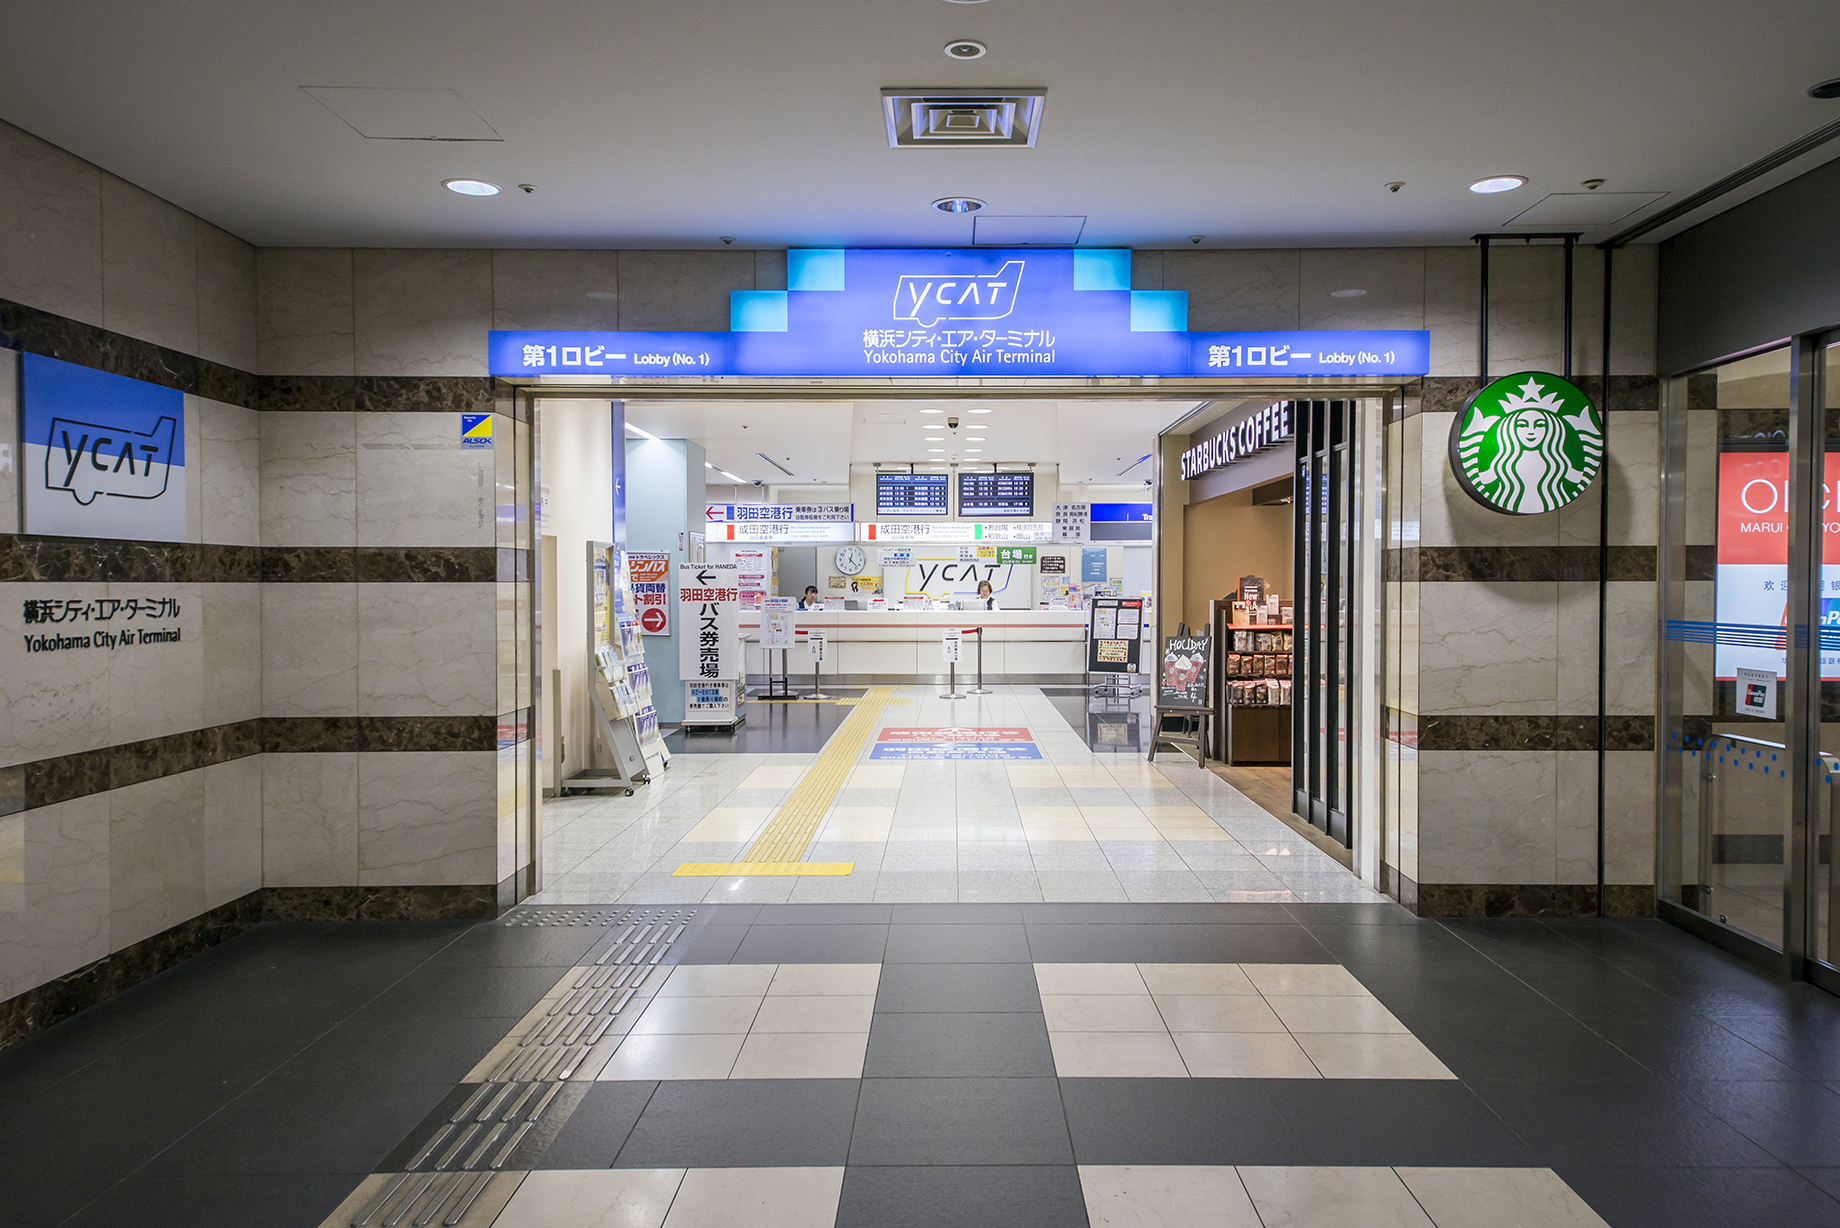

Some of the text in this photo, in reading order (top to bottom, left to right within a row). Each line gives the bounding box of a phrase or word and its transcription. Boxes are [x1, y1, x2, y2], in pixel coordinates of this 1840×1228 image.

[863, 330, 1056, 348] 横浜シティ・エア・ターミナル
[522, 345, 627, 368] 第1ロビー
[633, 353, 671, 367] Lobby
[863, 349, 1056, 367] Yokohama City Air Terminal
[1208, 345, 1311, 368] 第1ロビー
[1318, 352, 1356, 366] Lobby
[462, 437, 493, 445] ALSOK
[1181, 400, 1289, 481] STARBUCKS COFFEE
[736, 506, 794, 520] 羽田空港行
[738, 524, 790, 535] 成田空港行
[880, 524, 931, 535] 成田空港行
[1740, 522, 1783, 534] MARUI
[680, 588, 738, 601] 羽田空港行
[23, 597, 181, 625] 横浜シティ・エア・ターミナル
[24, 627, 181, 654] Yokohama City Air Terminal
[699, 602, 719, 678] バス券売場
[1169, 637, 1209, 651] HOLIDAY
